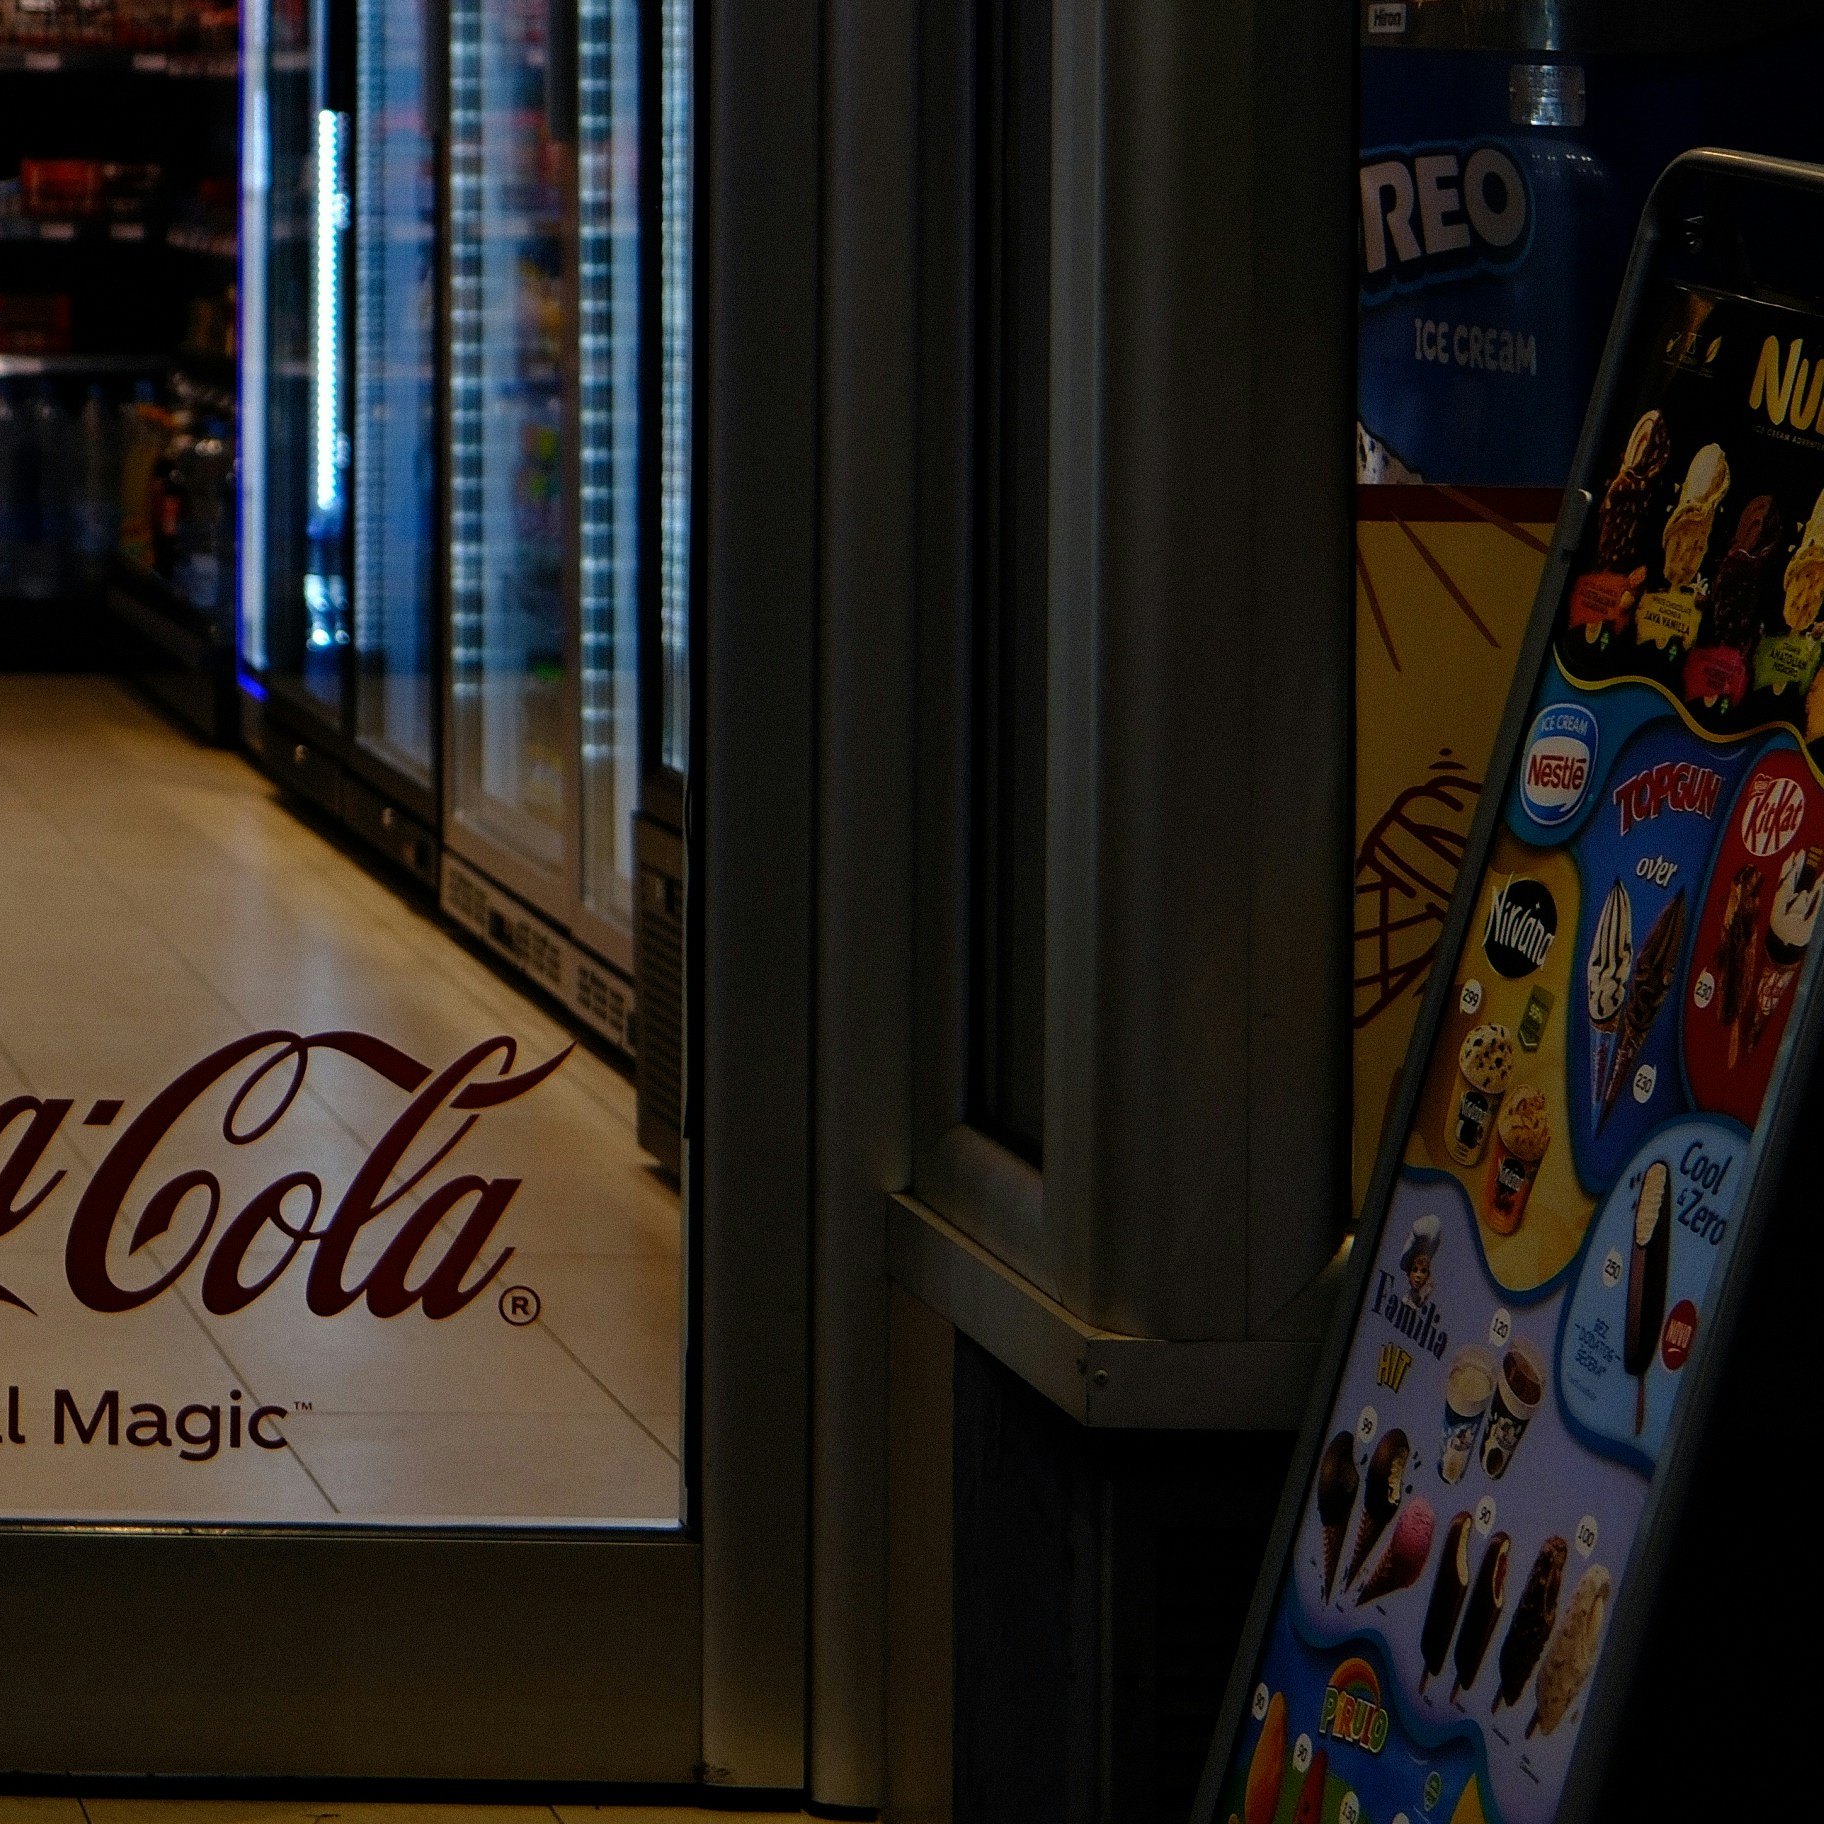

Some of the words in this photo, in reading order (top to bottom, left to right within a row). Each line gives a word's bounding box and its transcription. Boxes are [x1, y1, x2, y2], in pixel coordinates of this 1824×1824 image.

[1360, 147, 1528, 274] REO
[1413, 317, 1449, 366] ICE
[1636, 854, 1678, 889] over
[1481, 870, 1556, 972] Nirvana
[1462, 987, 1480, 1007] 299
[1634, 1075, 1653, 1095] 230
[1679, 1140, 1733, 1196] Cool
[1677, 1190, 1728, 1247] Zero
[1604, 1259, 1621, 1279] 250
[1370, 1269, 1449, 1361] Familia
[1491, 1317, 1510, 1337] 120
[1376, 1341, 1413, 1394] HIT
[1360, 1415, 1374, 1435] 99
[1478, 1504, 1492, 1525] 90
[1576, 1524, 1596, 1545] 100
